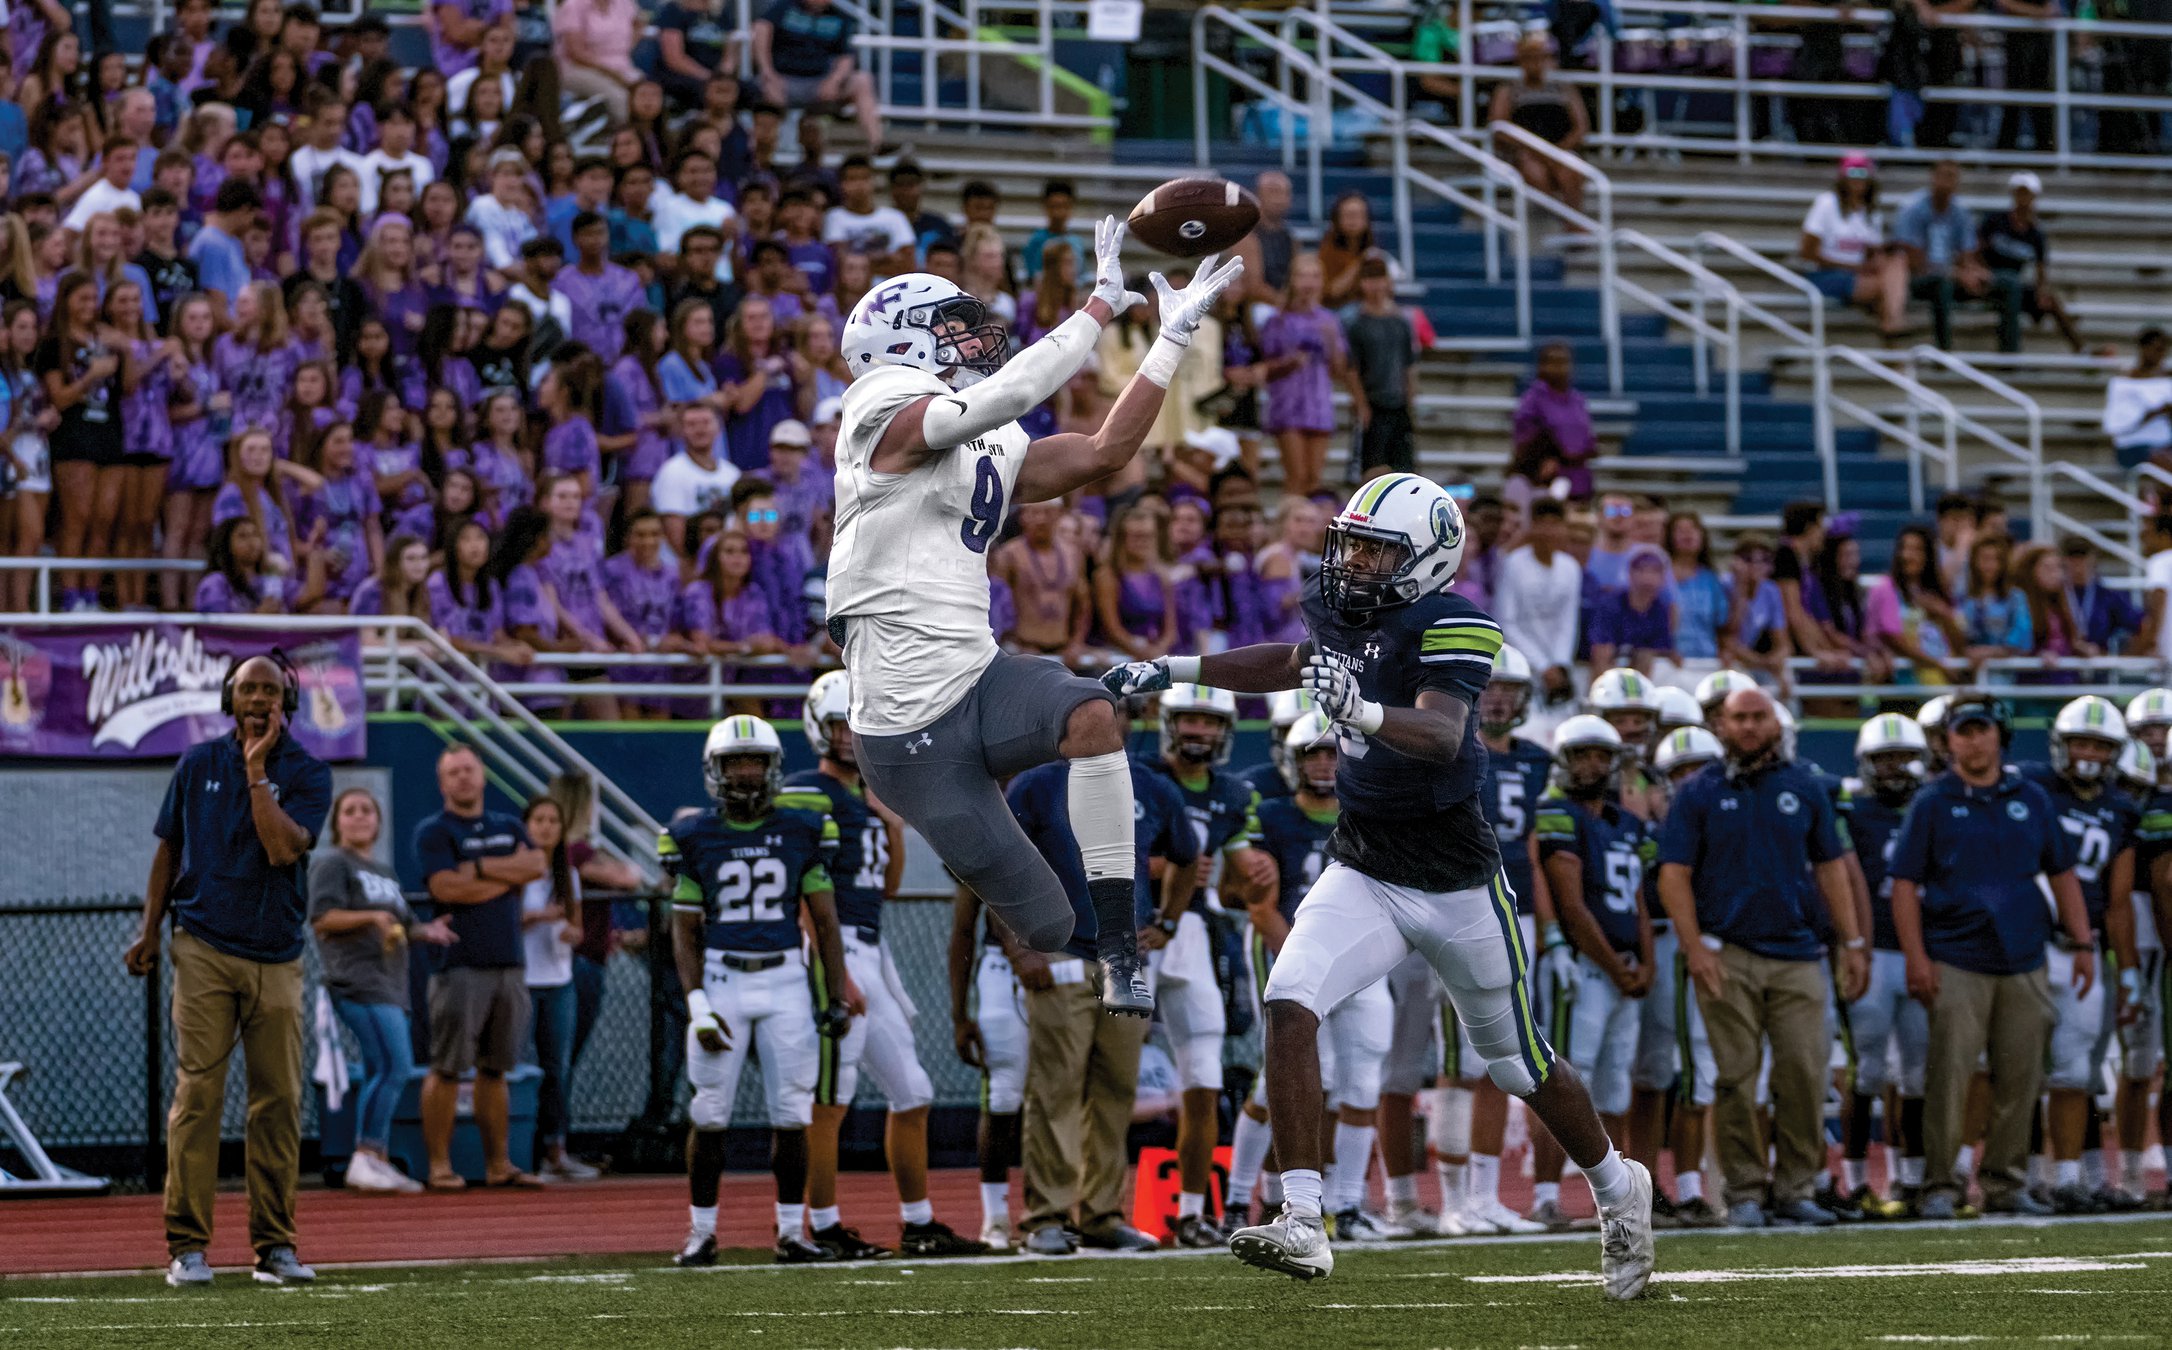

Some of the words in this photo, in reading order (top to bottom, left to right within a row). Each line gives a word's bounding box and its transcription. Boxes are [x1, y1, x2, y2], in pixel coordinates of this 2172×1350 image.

[960, 455, 1004, 554] 9
[1331, 650, 1365, 673] TITANS
[717, 857, 787, 922] 22
